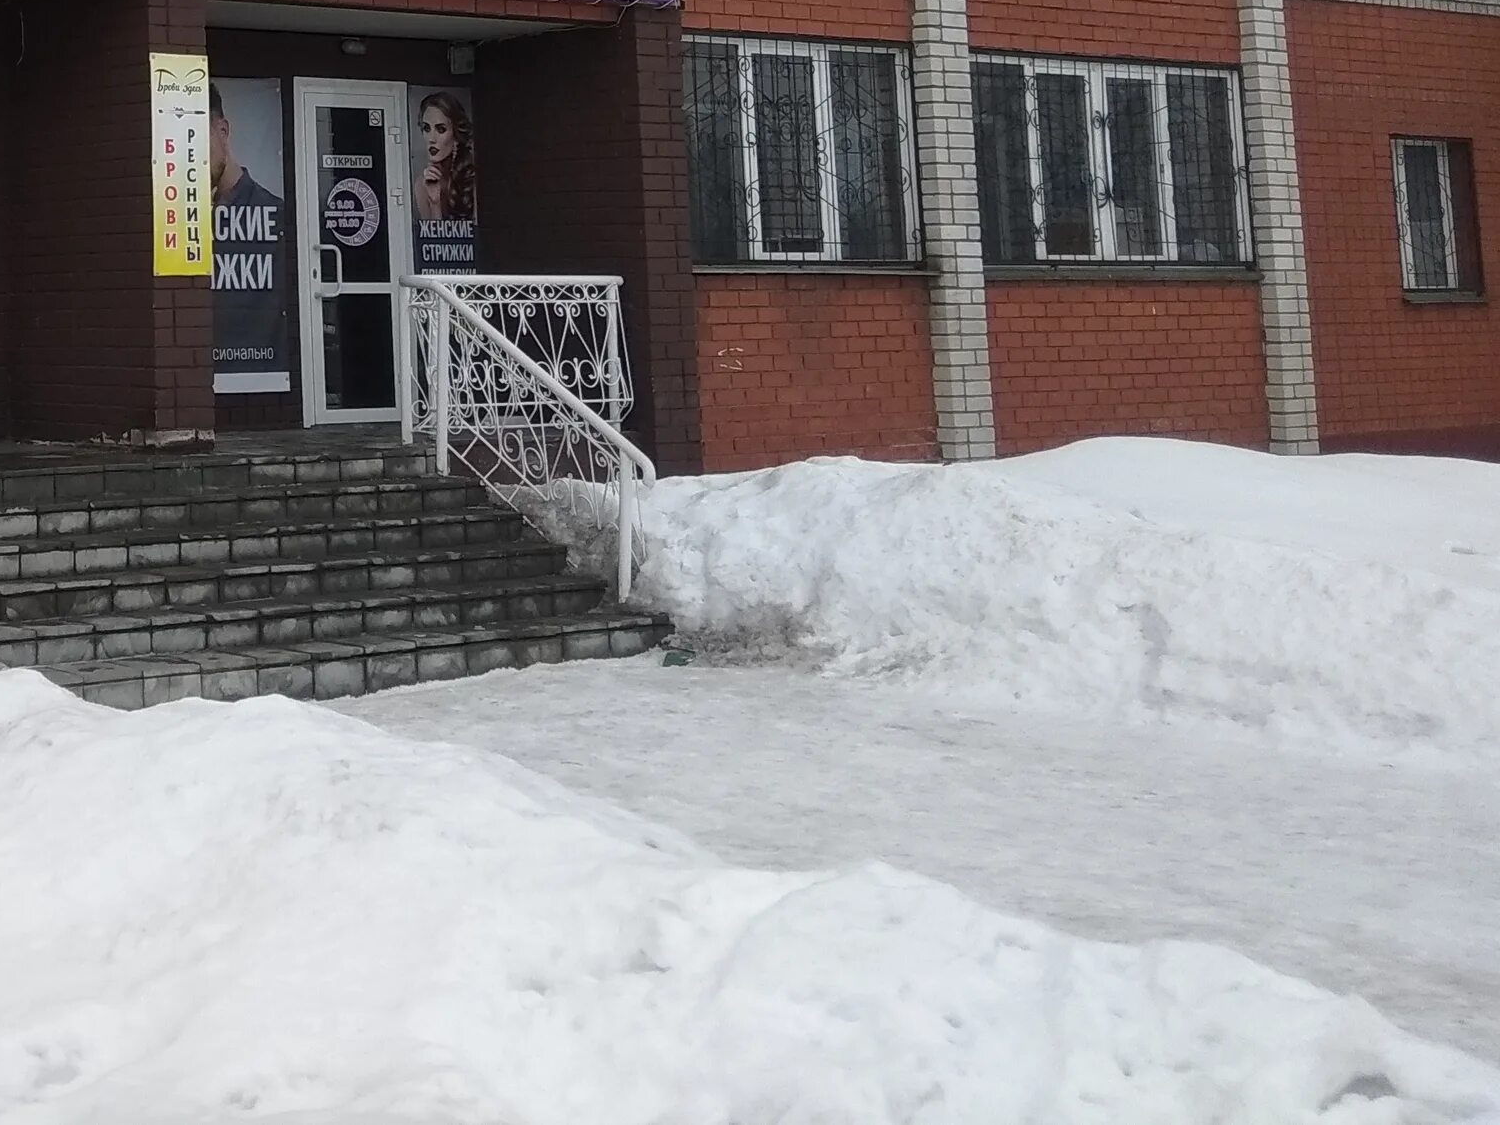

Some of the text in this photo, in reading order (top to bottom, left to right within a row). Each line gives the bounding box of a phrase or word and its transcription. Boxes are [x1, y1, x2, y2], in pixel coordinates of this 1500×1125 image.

[324, 157, 371, 167] ОТКРЫТО
[164, 138, 177, 249] БРОВИ
[186, 128, 201, 262] РЕСНИЦЫ
[211, 204, 278, 241] СКИЕ
[419, 220, 474, 238] ЖЕНСКИЕ
[422, 244, 474, 262] СТРИЖКИ
